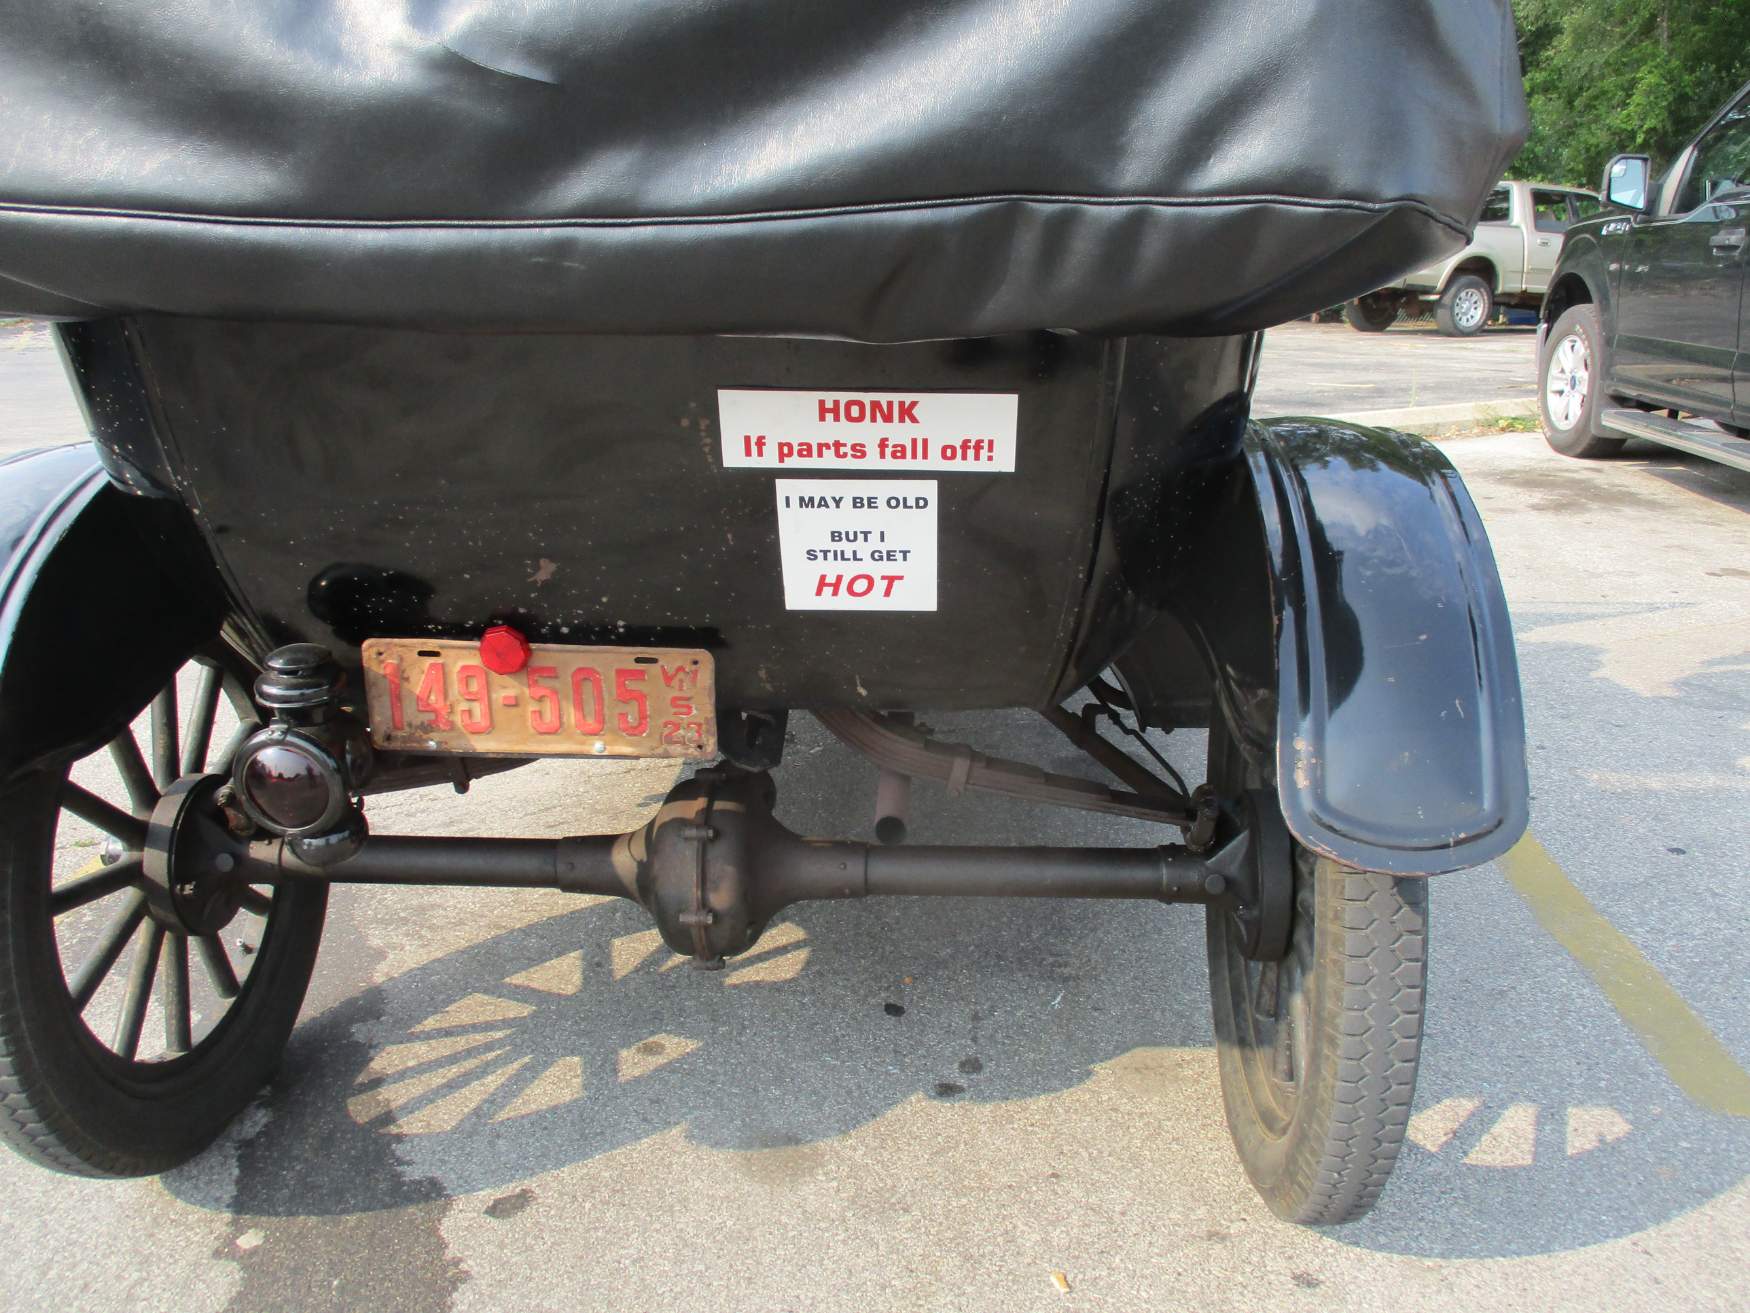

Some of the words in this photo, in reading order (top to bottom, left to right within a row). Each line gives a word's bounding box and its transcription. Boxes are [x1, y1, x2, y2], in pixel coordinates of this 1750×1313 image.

[818, 399, 920, 423] HONK
[743, 435, 766, 457] If
[778, 439, 867, 463] parts
[878, 437, 929, 460] fall
[940, 439, 995, 461] off!
[785, 495, 790, 508] I
[799, 496, 844, 509] MAY
[852, 497, 878, 509] BE
[886, 497, 929, 509] OLD
[831, 531, 872, 542] BUT
[880, 531, 885, 542] I
[806, 549, 863, 561] STILL
[871, 550, 911, 561] GET
[815, 574, 904, 597] HOT
[384, 661, 651, 737] 149-505
